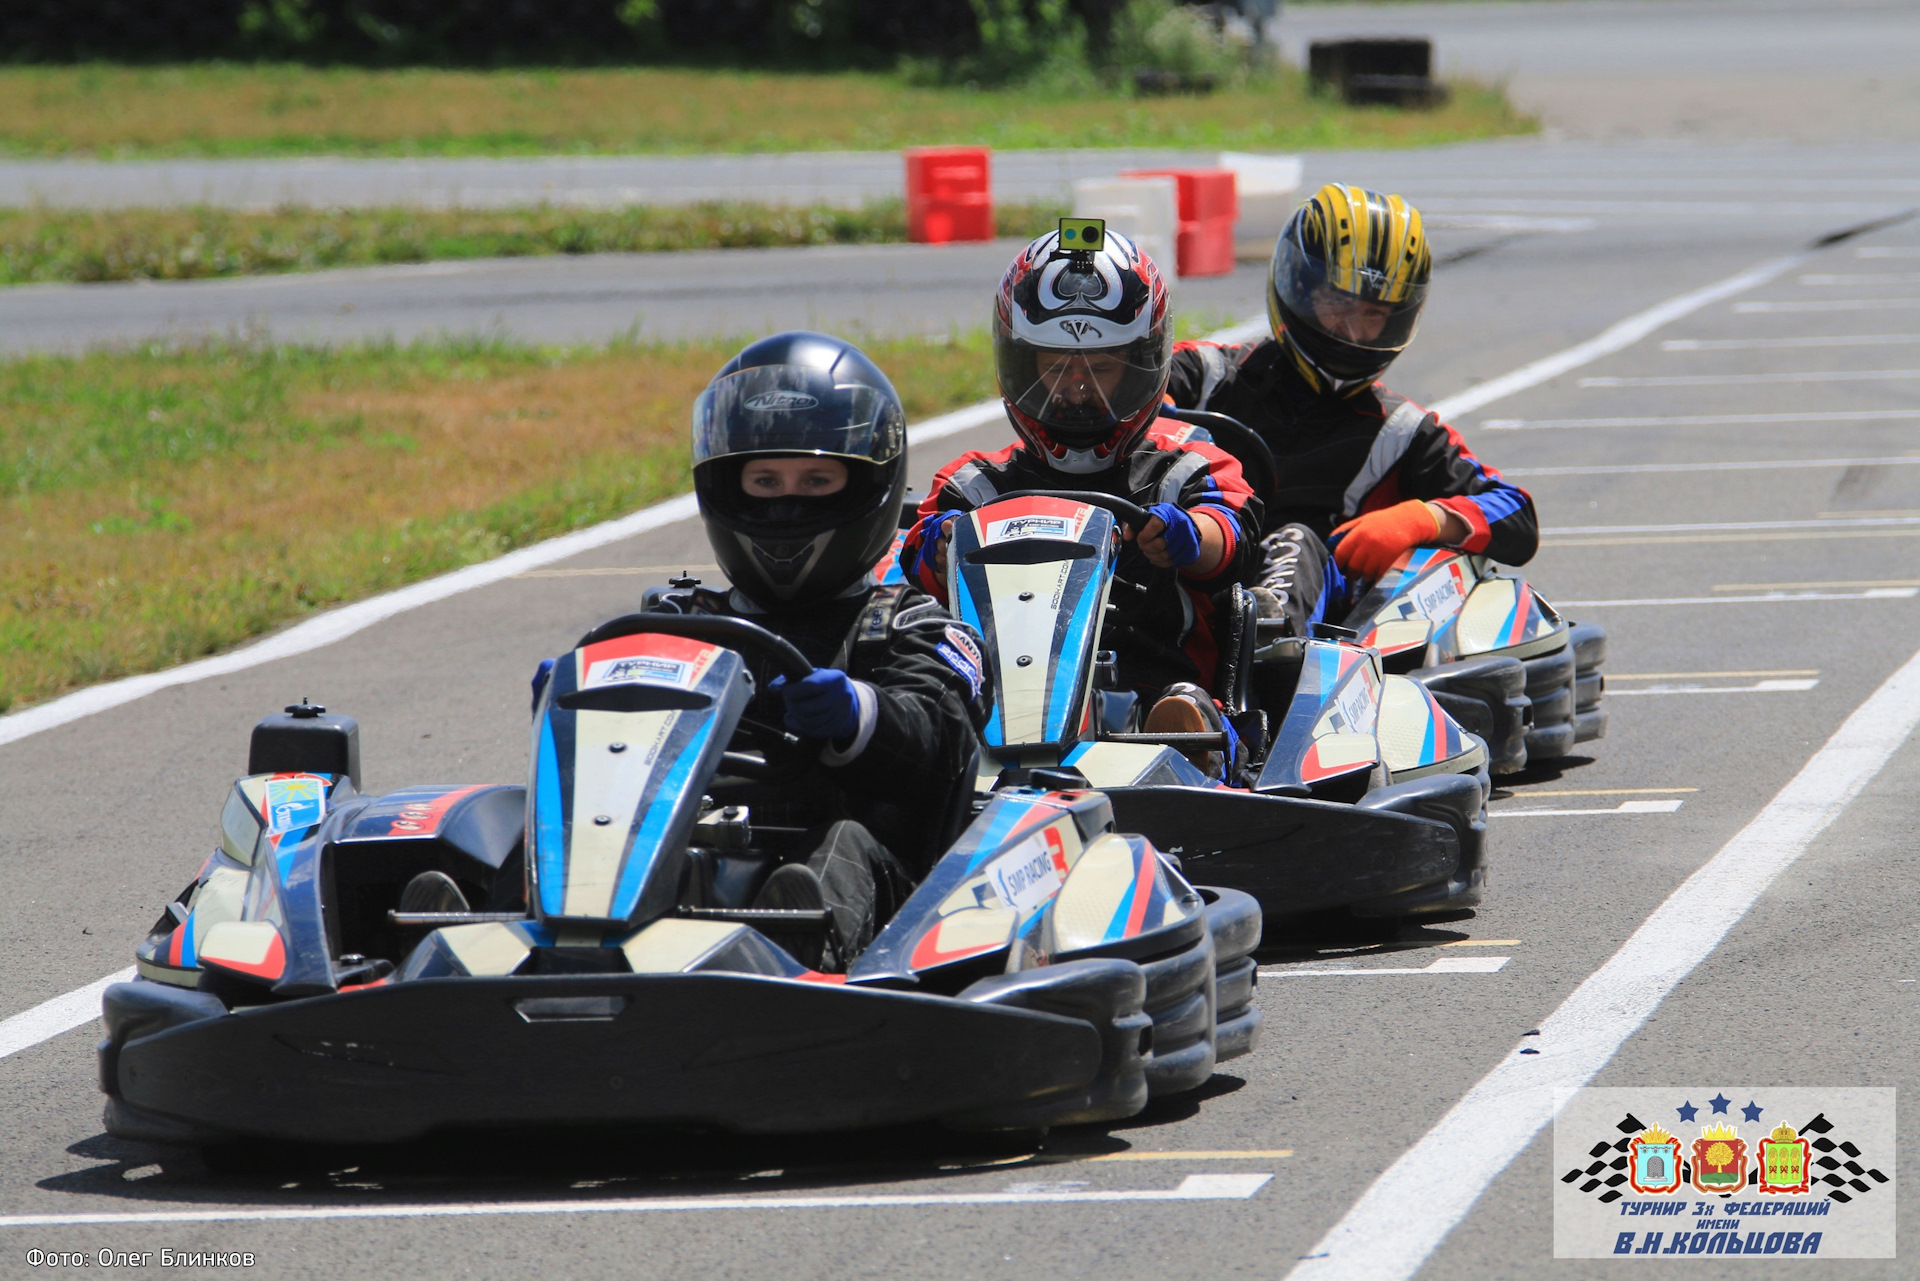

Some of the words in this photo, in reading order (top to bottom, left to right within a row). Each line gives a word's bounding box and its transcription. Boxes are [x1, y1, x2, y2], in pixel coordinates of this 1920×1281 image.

[754, 393, 811, 407] Nitro
[1007, 869, 1027, 896] SMP
[1023, 851, 1052, 886] RACING
